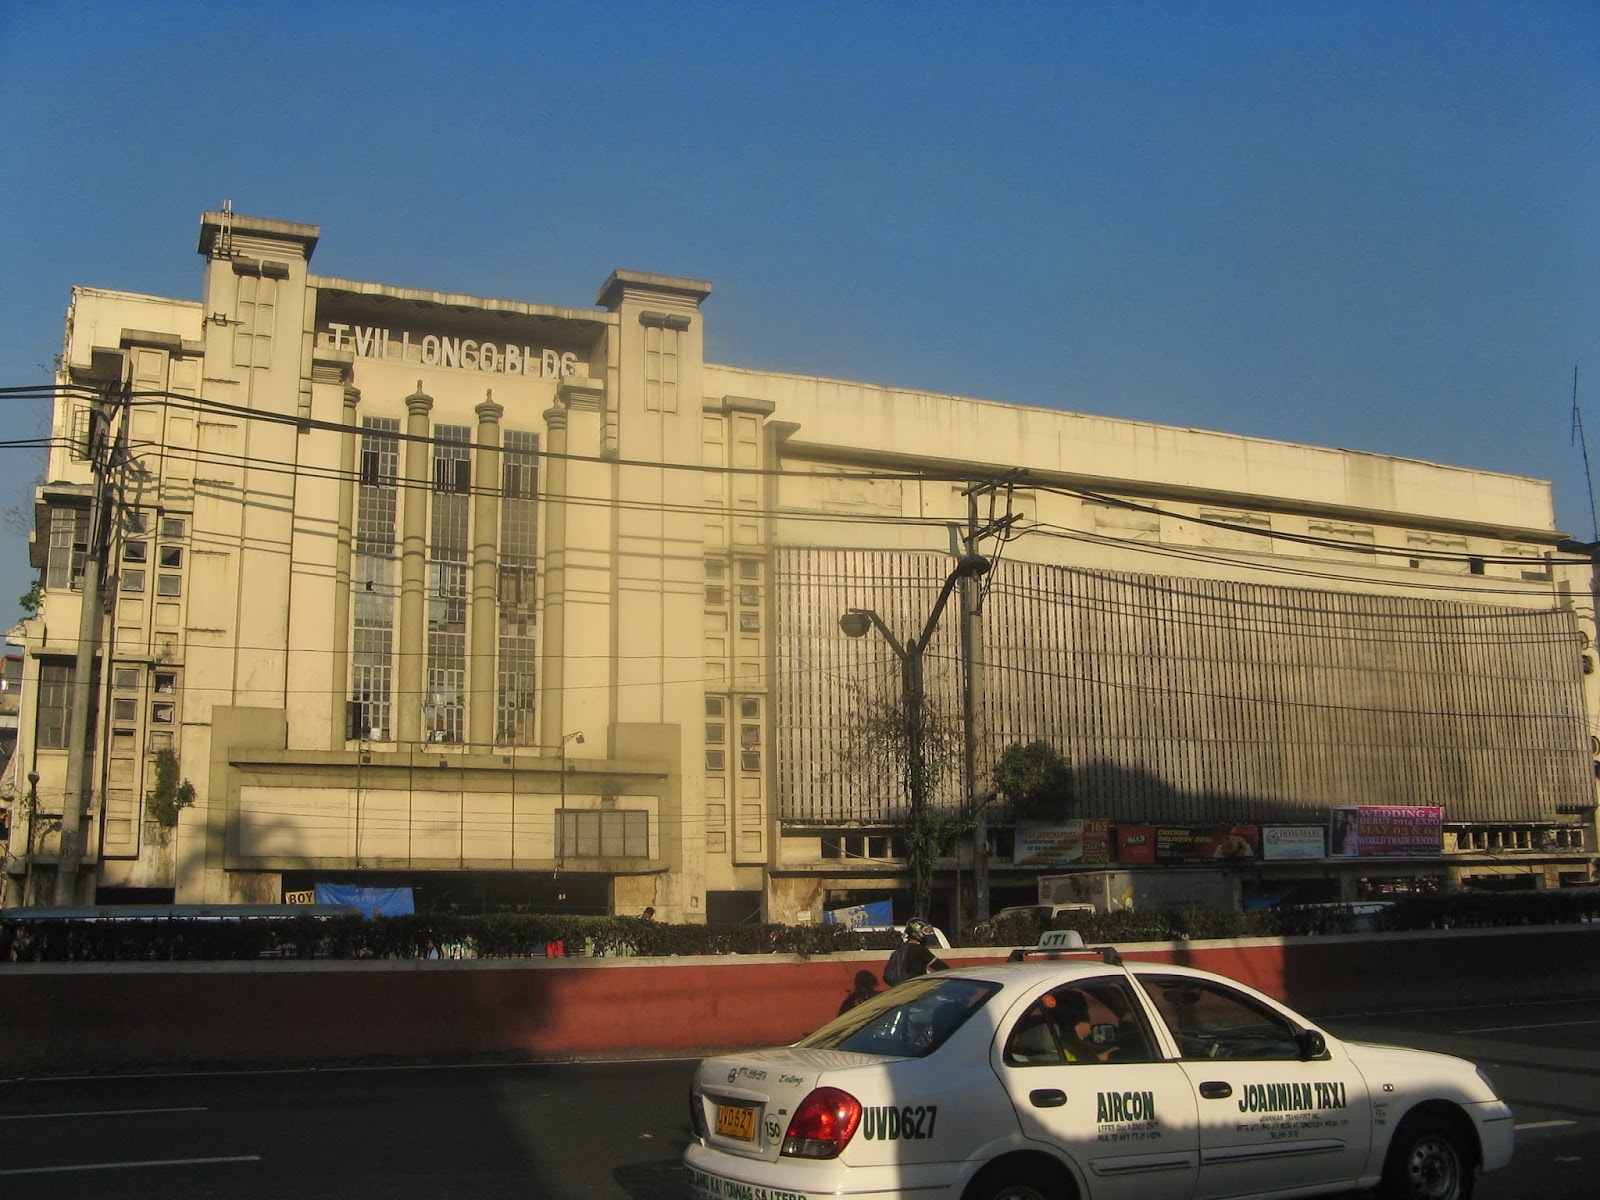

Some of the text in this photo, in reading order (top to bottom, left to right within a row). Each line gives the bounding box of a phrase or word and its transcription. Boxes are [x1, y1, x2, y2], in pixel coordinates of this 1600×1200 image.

[1360, 809, 1438, 818] WEDDING &
[1360, 825, 1439, 836] MAY 03 & 04
[1358, 836, 1440, 845] WORLD TRADE CENTER
[289, 892, 313, 904] BOY
[1042, 934, 1066, 946] JTI
[1238, 1082, 1347, 1113] JOANNIAN TAXI
[1096, 1091, 1155, 1123] AIRCON
[863, 1105, 938, 1141] UVD627
[765, 1121, 780, 1138] 150
